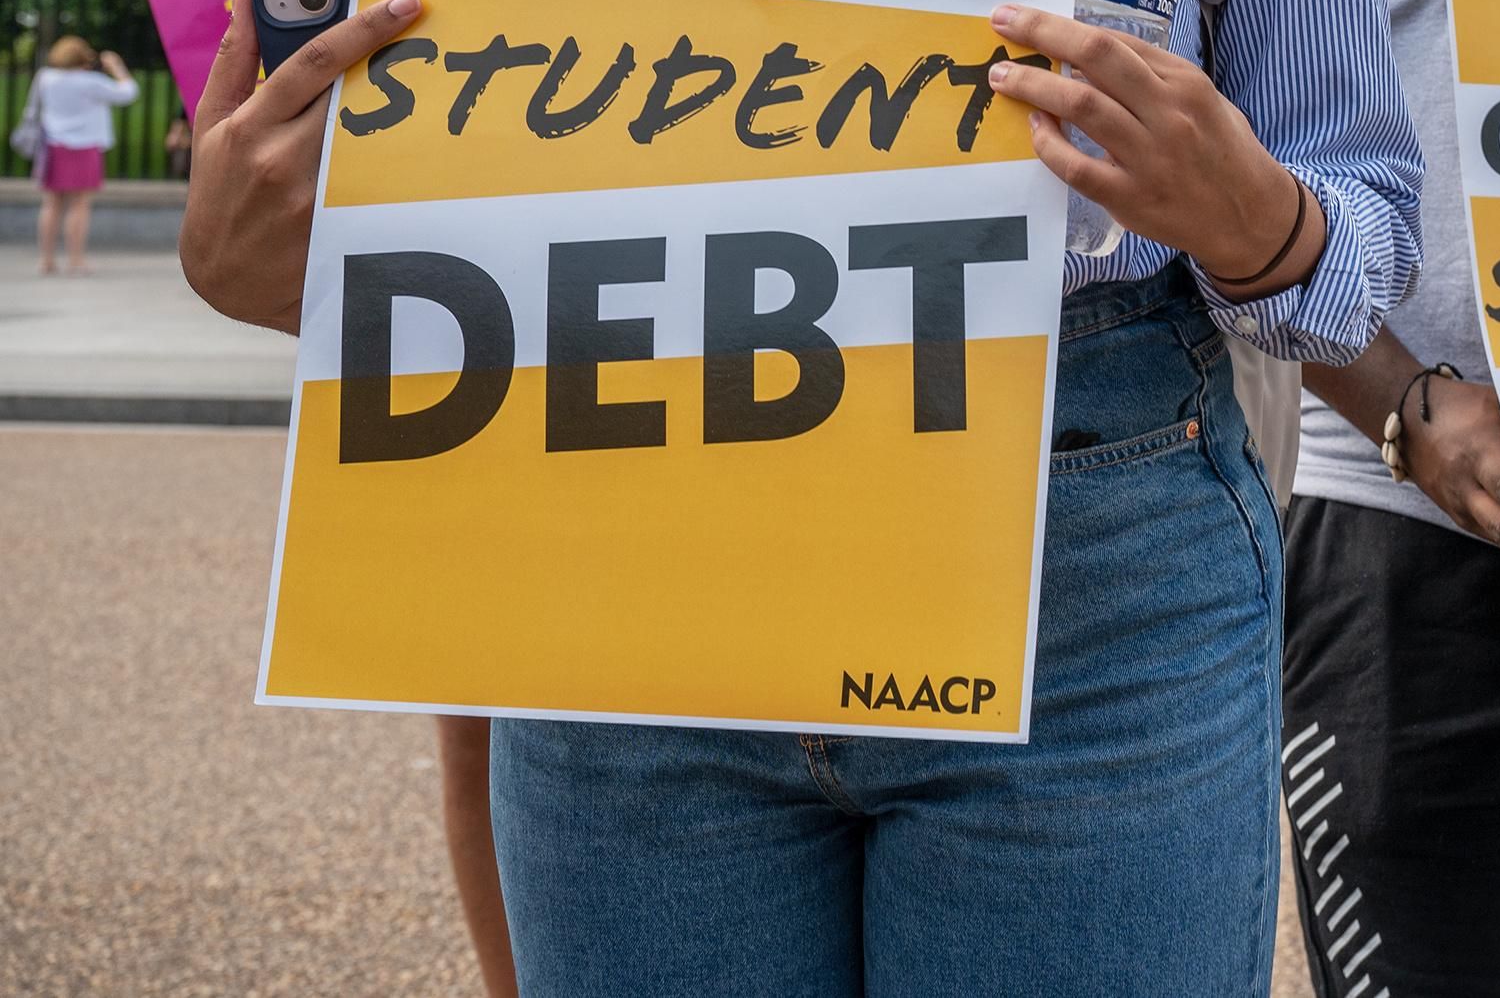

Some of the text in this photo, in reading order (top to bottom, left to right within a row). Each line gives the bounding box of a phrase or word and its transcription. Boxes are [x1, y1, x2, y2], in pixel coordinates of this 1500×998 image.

[340, 34, 1053, 152] STUDENT
[339, 215, 1028, 464] DEBT
[841, 670, 997, 714] NAACP
